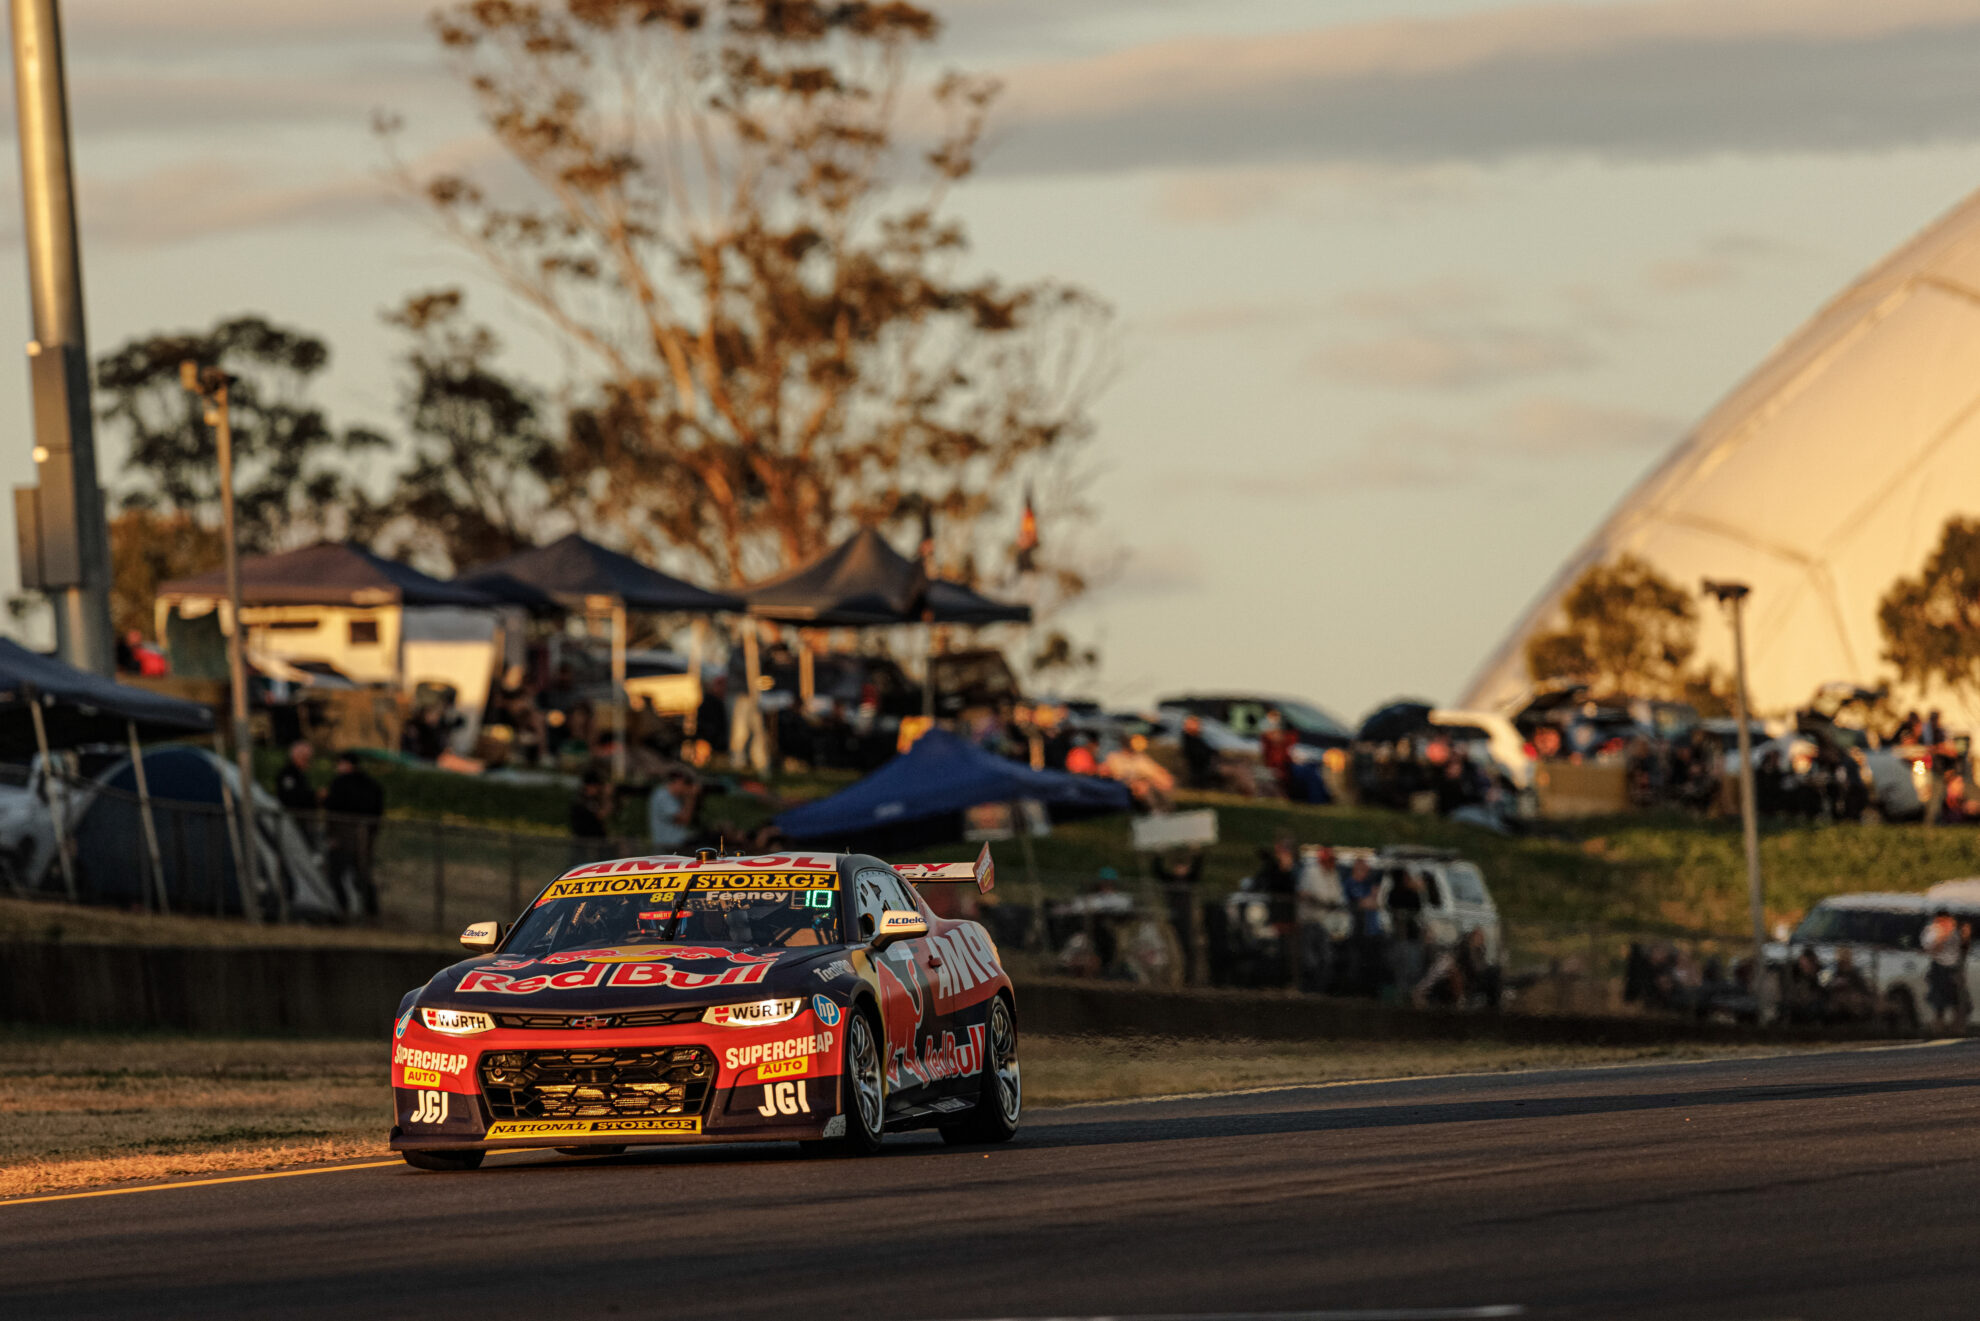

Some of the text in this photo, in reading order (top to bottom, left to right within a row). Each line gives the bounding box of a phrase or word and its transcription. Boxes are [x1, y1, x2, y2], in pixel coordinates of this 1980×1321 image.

[566, 856, 831, 878] AMPOL
[551, 873, 831, 896] NATIONAL STORAGE
[650, 892, 675, 903] 88
[706, 891, 788, 903] Feeney
[805, 890, 832, 908] 10
[455, 961, 778, 994] Red Bull
[733, 1001, 794, 1020] WÜRTH
[438, 1012, 487, 1029] WÜRTH
[395, 1043, 468, 1075] SUPERCHEAP
[726, 1031, 833, 1069] SUPERCHEAP
[925, 1023, 985, 1081] Red Bull
[763, 1060, 803, 1075] AUTO
[408, 1071, 437, 1083] AUTO
[492, 1119, 692, 1134] NATIONAL STORAGE
